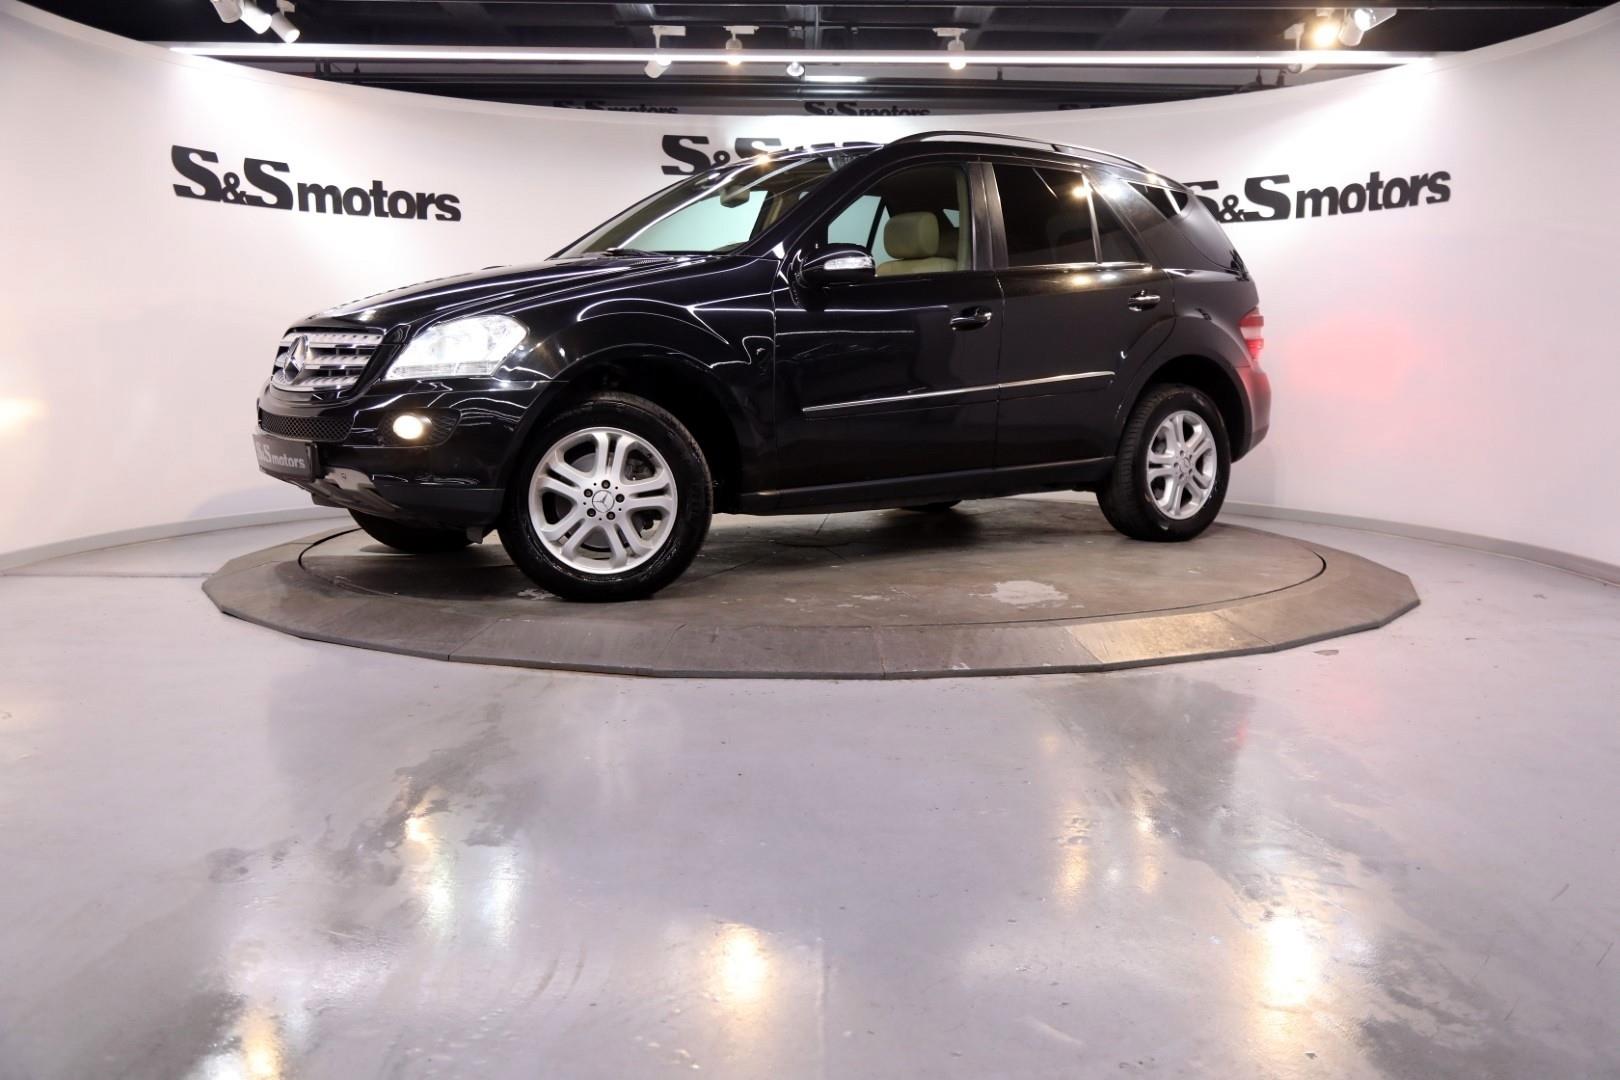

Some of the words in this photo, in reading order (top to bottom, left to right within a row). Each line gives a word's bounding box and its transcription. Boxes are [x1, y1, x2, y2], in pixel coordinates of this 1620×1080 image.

[171, 144, 294, 210] S&S
[297, 179, 462, 222] motors
[1295, 171, 1452, 219] motors
[271, 453, 306, 469] motors
